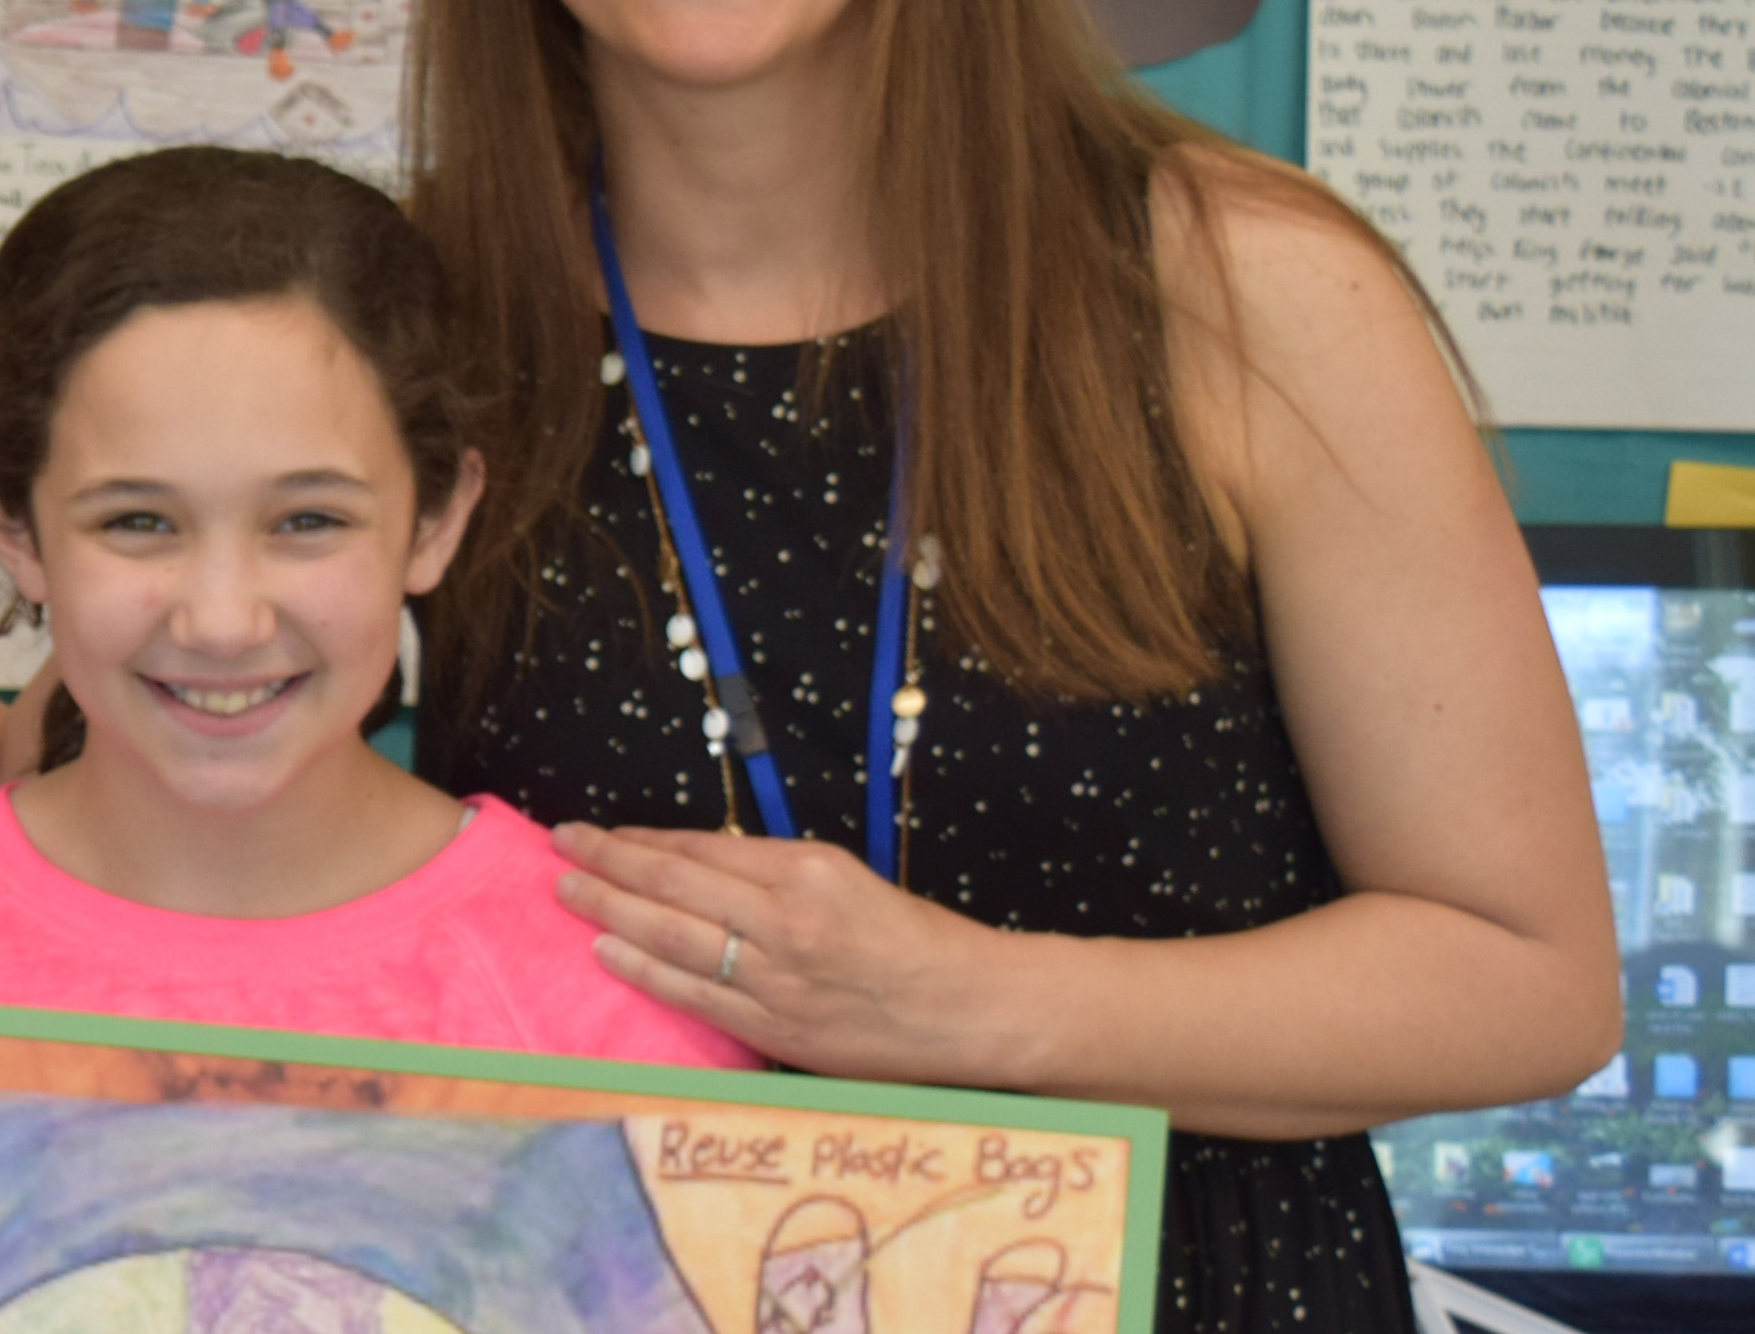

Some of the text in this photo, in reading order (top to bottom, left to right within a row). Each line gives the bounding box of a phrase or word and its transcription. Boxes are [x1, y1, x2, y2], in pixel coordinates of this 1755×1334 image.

[658, 1122, 1101, 1220] Reuse Plastic Bags
